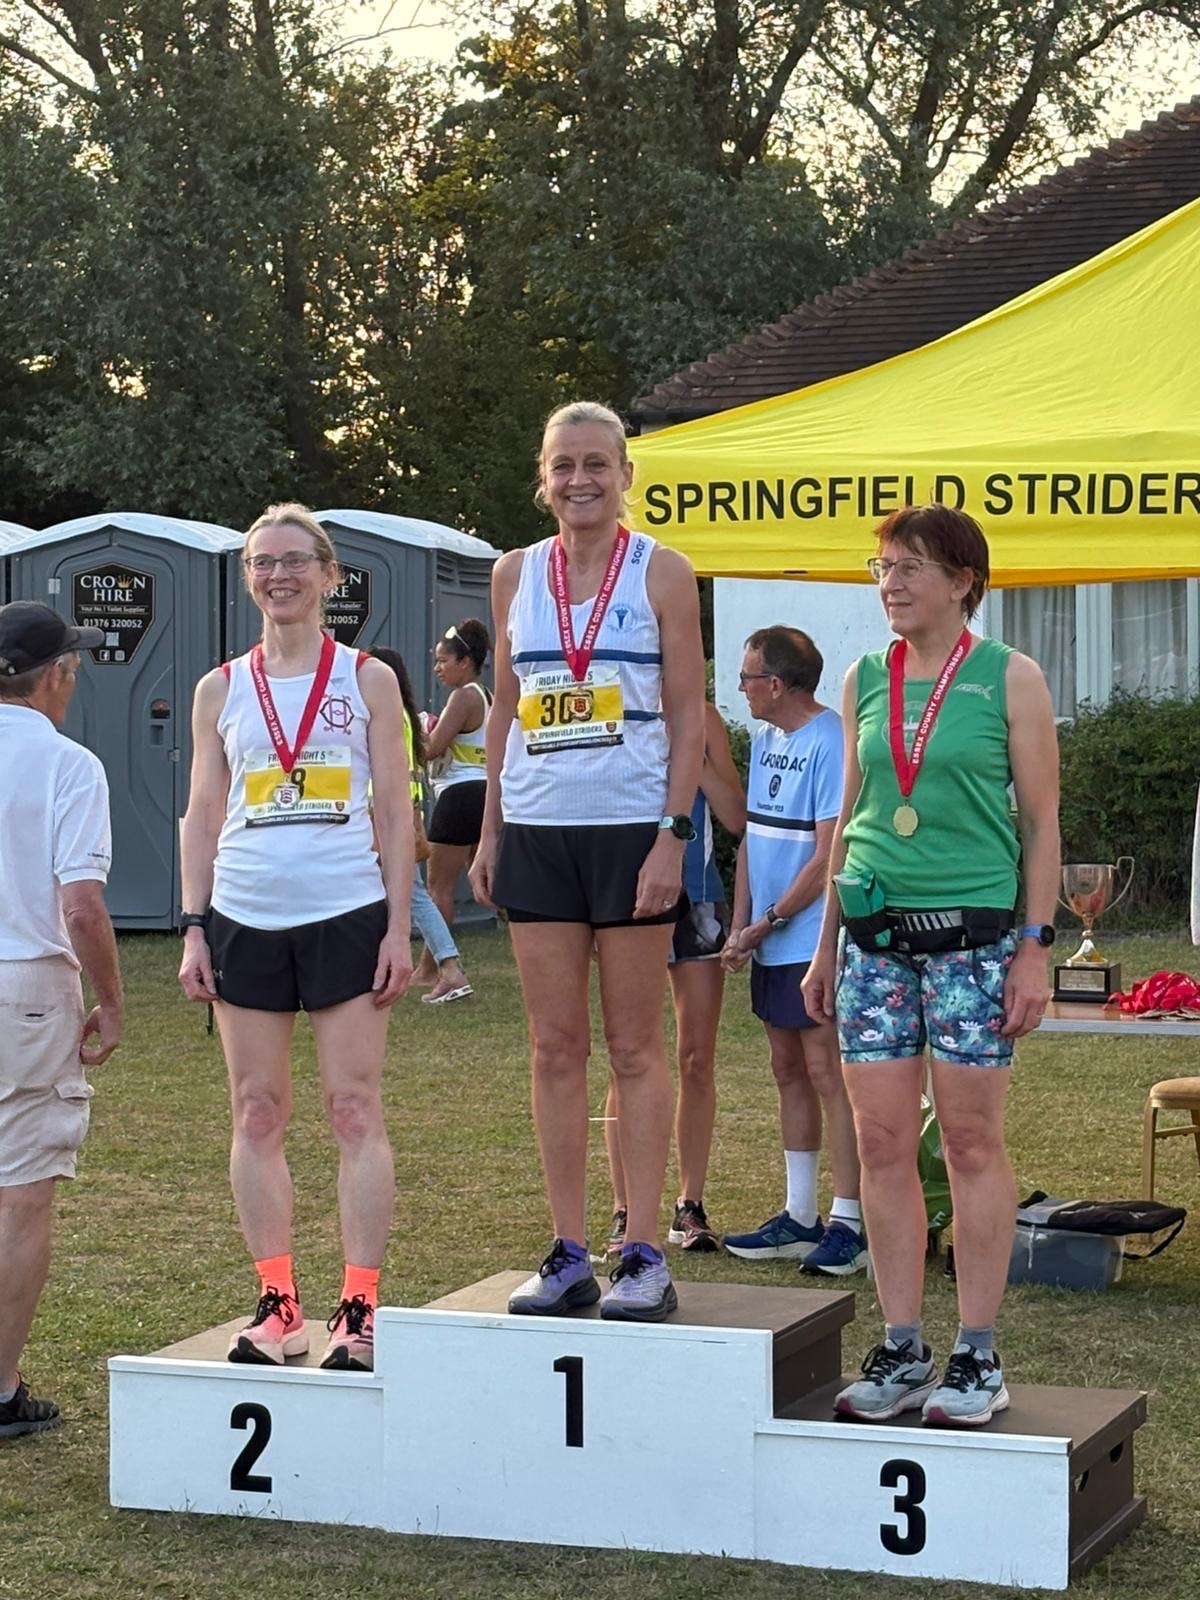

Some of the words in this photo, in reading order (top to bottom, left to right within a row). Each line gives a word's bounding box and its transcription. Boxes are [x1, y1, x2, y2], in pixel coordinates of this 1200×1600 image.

[645, 475, 965, 525] SPRINGFIELD
[984, 473, 1200, 515] STRIDER
[93, 589, 134, 602] HIRE
[327, 615, 359, 625] 320052
[592, 593, 608, 622] COUNTY
[111, 618, 143, 629] 320052
[912, 736, 924, 764] ESSEX
[920, 701, 937, 734] COUNTY
[933, 645, 964, 700] CHAMPIONSHIP
[553, 1355, 584, 1448] 1
[230, 1402, 272, 1494] 2
[880, 1458, 926, 1556] 3
